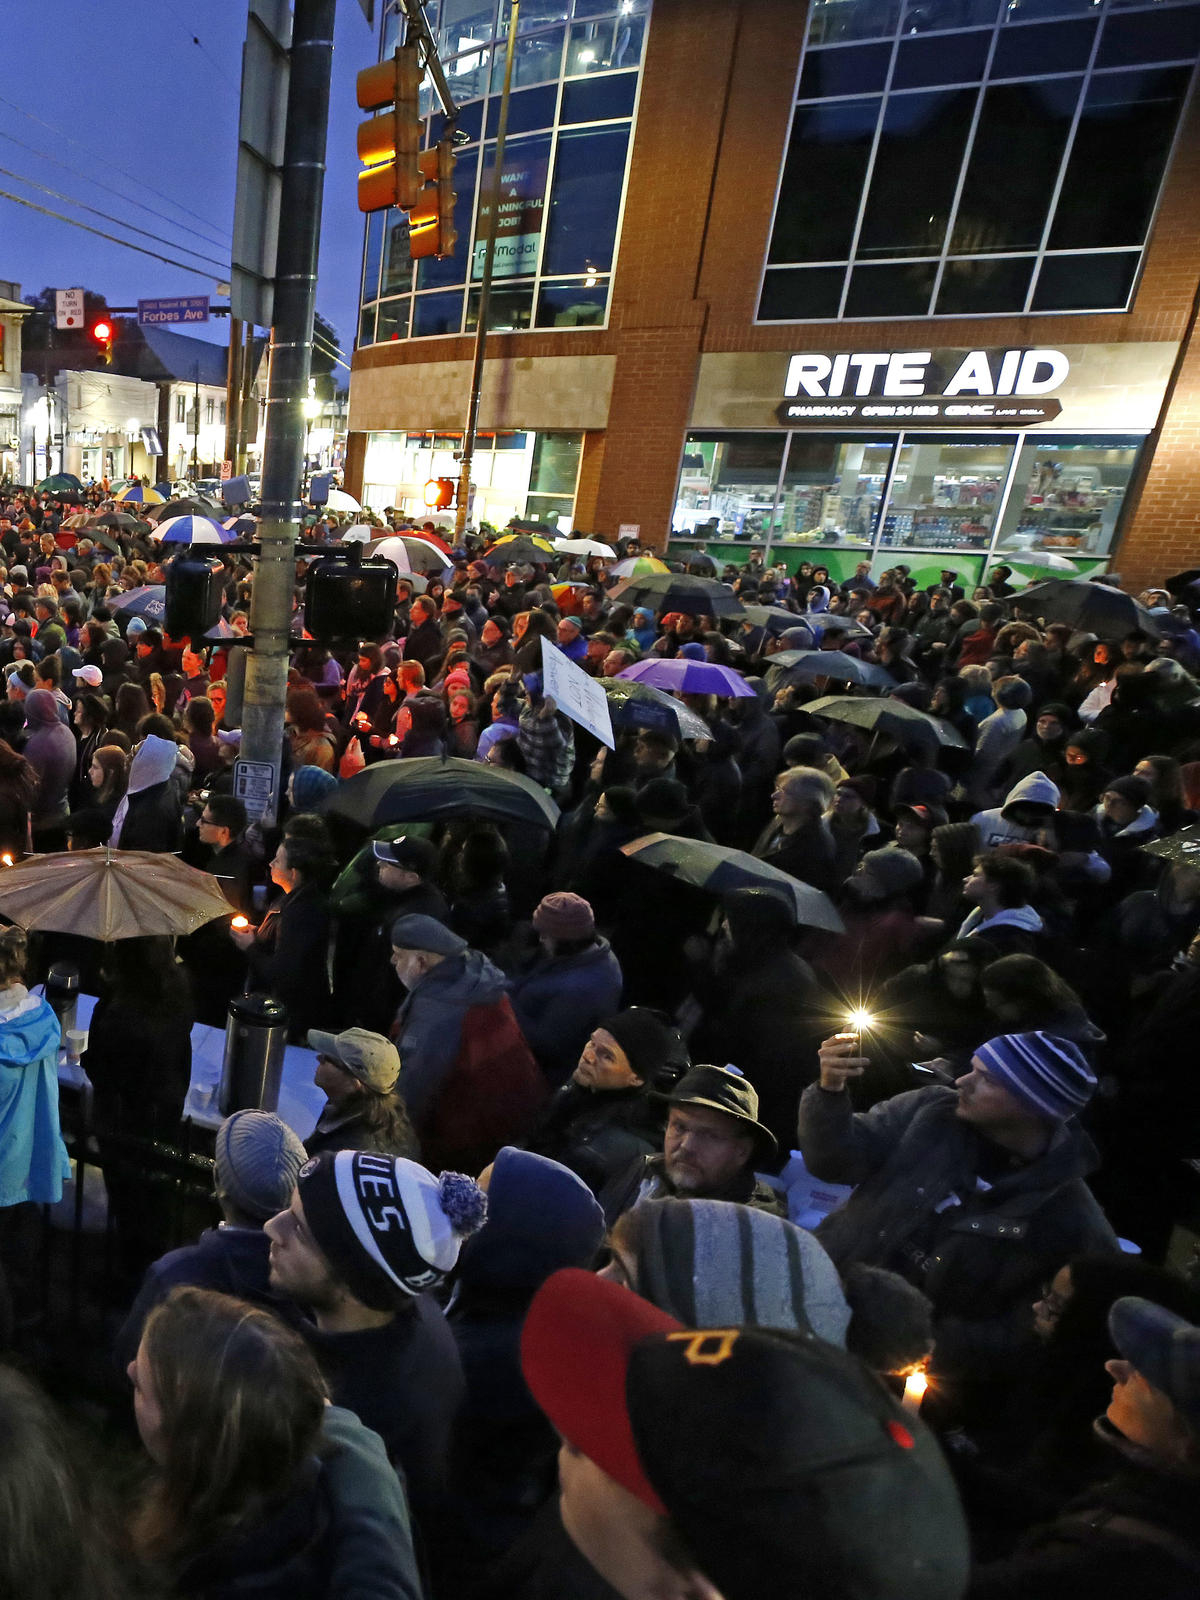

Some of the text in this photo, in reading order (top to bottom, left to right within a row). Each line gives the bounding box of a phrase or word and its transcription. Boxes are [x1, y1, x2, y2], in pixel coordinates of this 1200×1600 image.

[509, 188, 517, 197] A
[481, 199, 544, 215] MANINGFUL
[395, 227, 409, 241] TO
[65, 291, 75, 299] NO
[71, 308, 82, 316] RED
[142, 309, 204, 322] Forbes Ave
[784, 349, 1071, 397] RITE AID
[787, 405, 857, 417] PHARMACY
[861, 405, 895, 416] OPEN
[895, 405, 913, 416] 24
[912, 404, 939, 416] HRS
[666, 1329, 740, 1366] P
